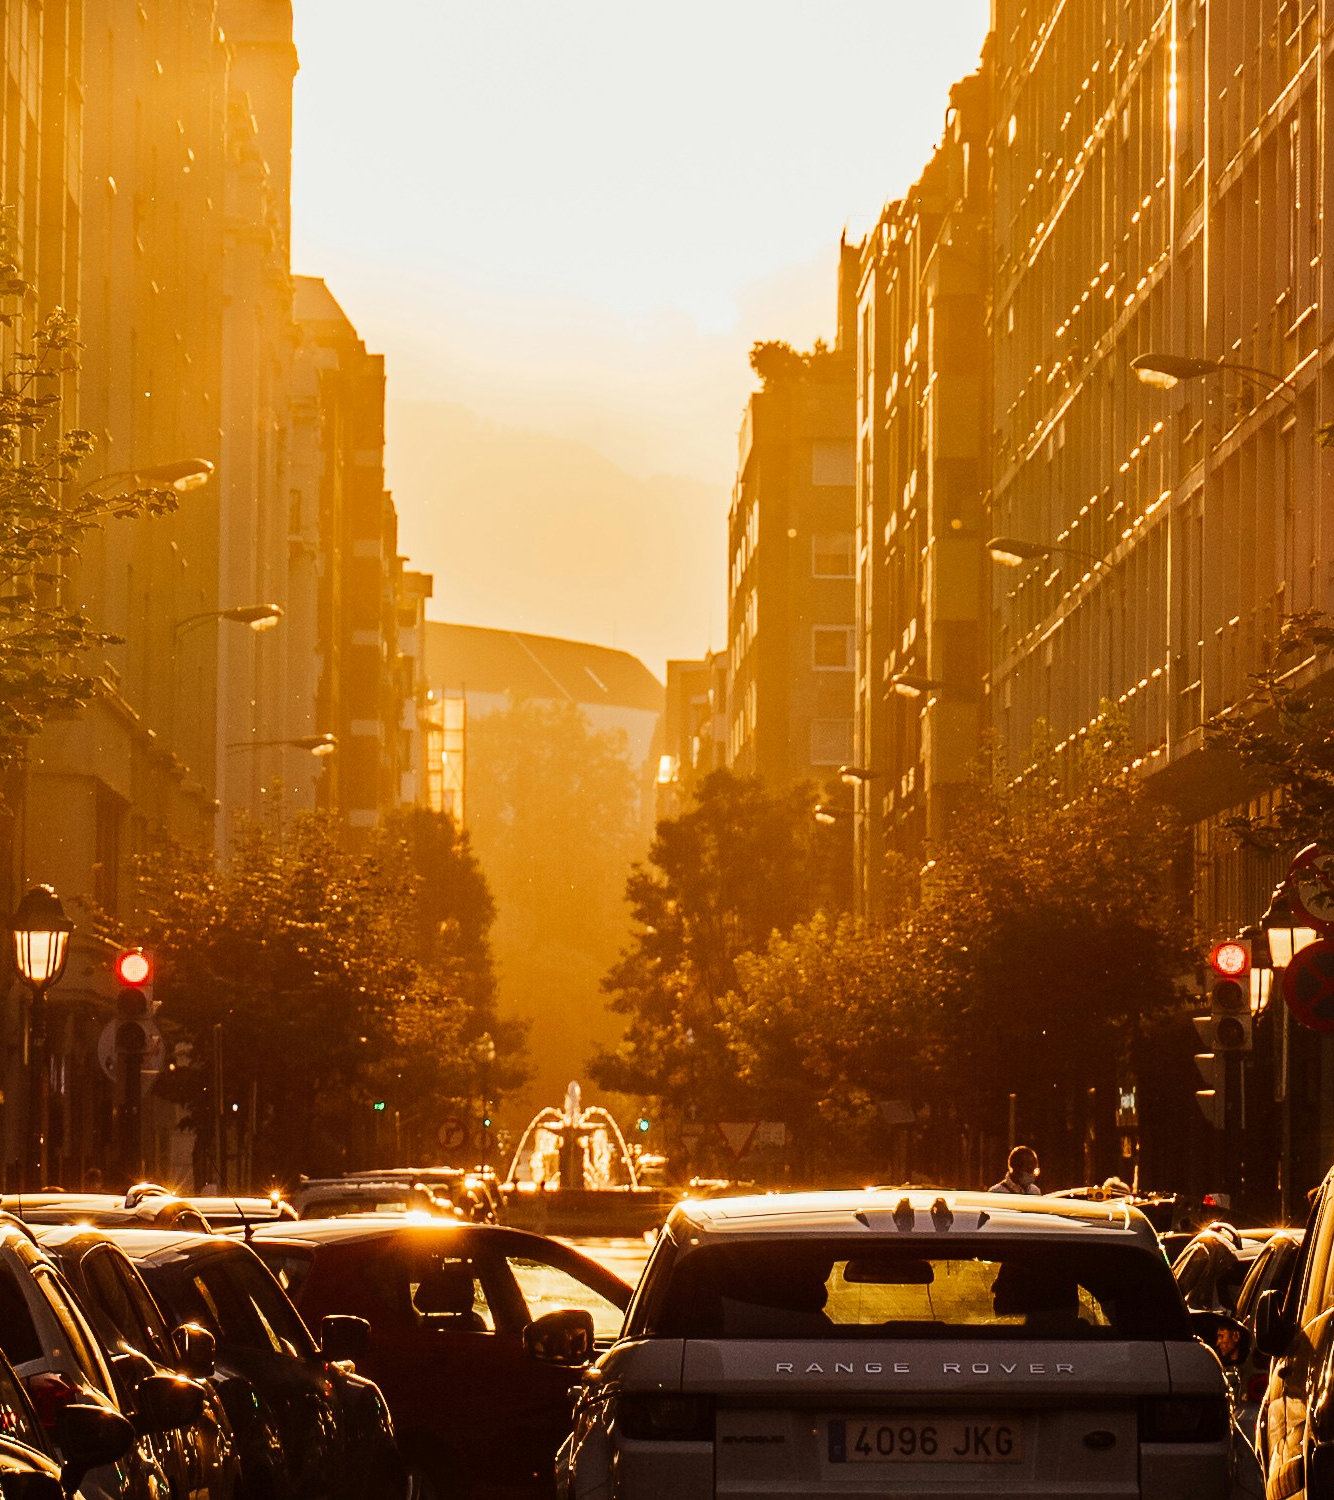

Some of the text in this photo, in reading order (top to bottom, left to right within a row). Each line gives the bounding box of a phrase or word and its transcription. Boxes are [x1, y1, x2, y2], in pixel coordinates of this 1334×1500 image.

[776, 1362, 1075, 1375] RANGE ROVER
[854, 1425, 1014, 1456] 4096 JKG
